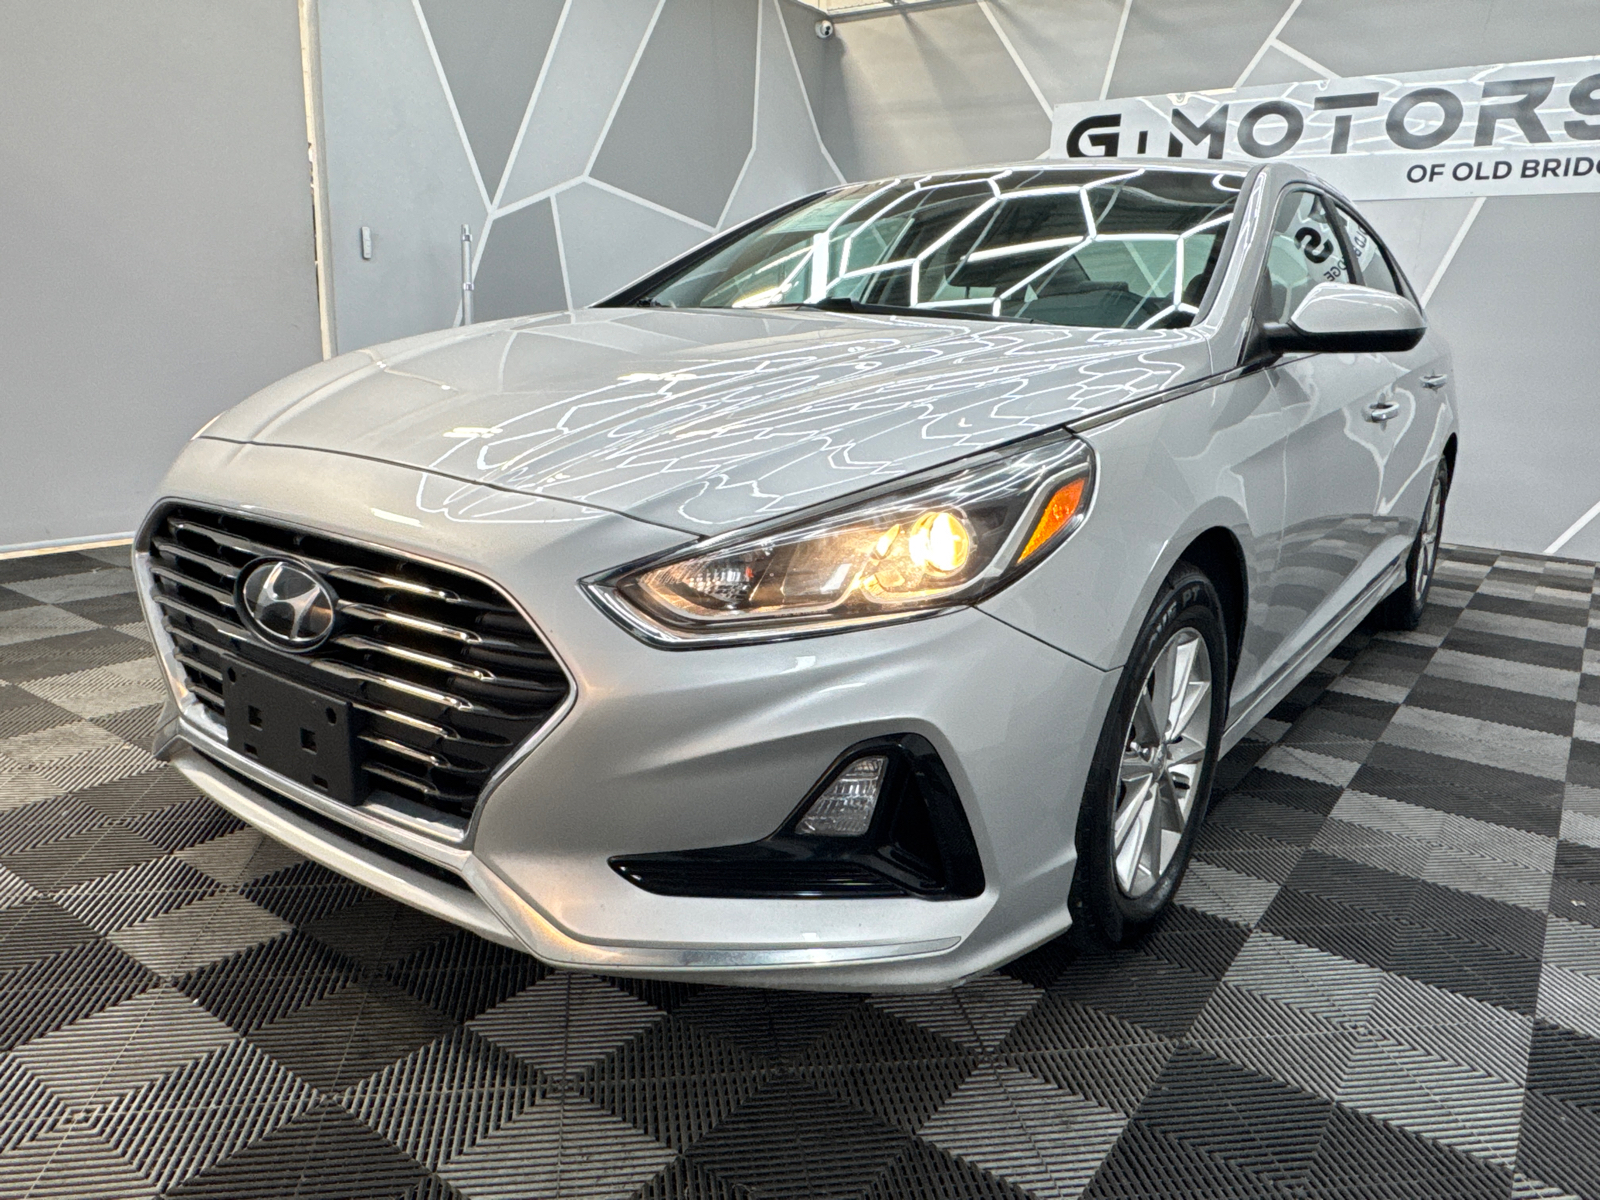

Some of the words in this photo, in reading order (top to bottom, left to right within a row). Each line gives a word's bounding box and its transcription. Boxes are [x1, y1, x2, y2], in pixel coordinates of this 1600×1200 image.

[1406, 163, 1446, 184] OF
[1452, 160, 1513, 182] OLD
[1520, 156, 1600, 179] BRID
